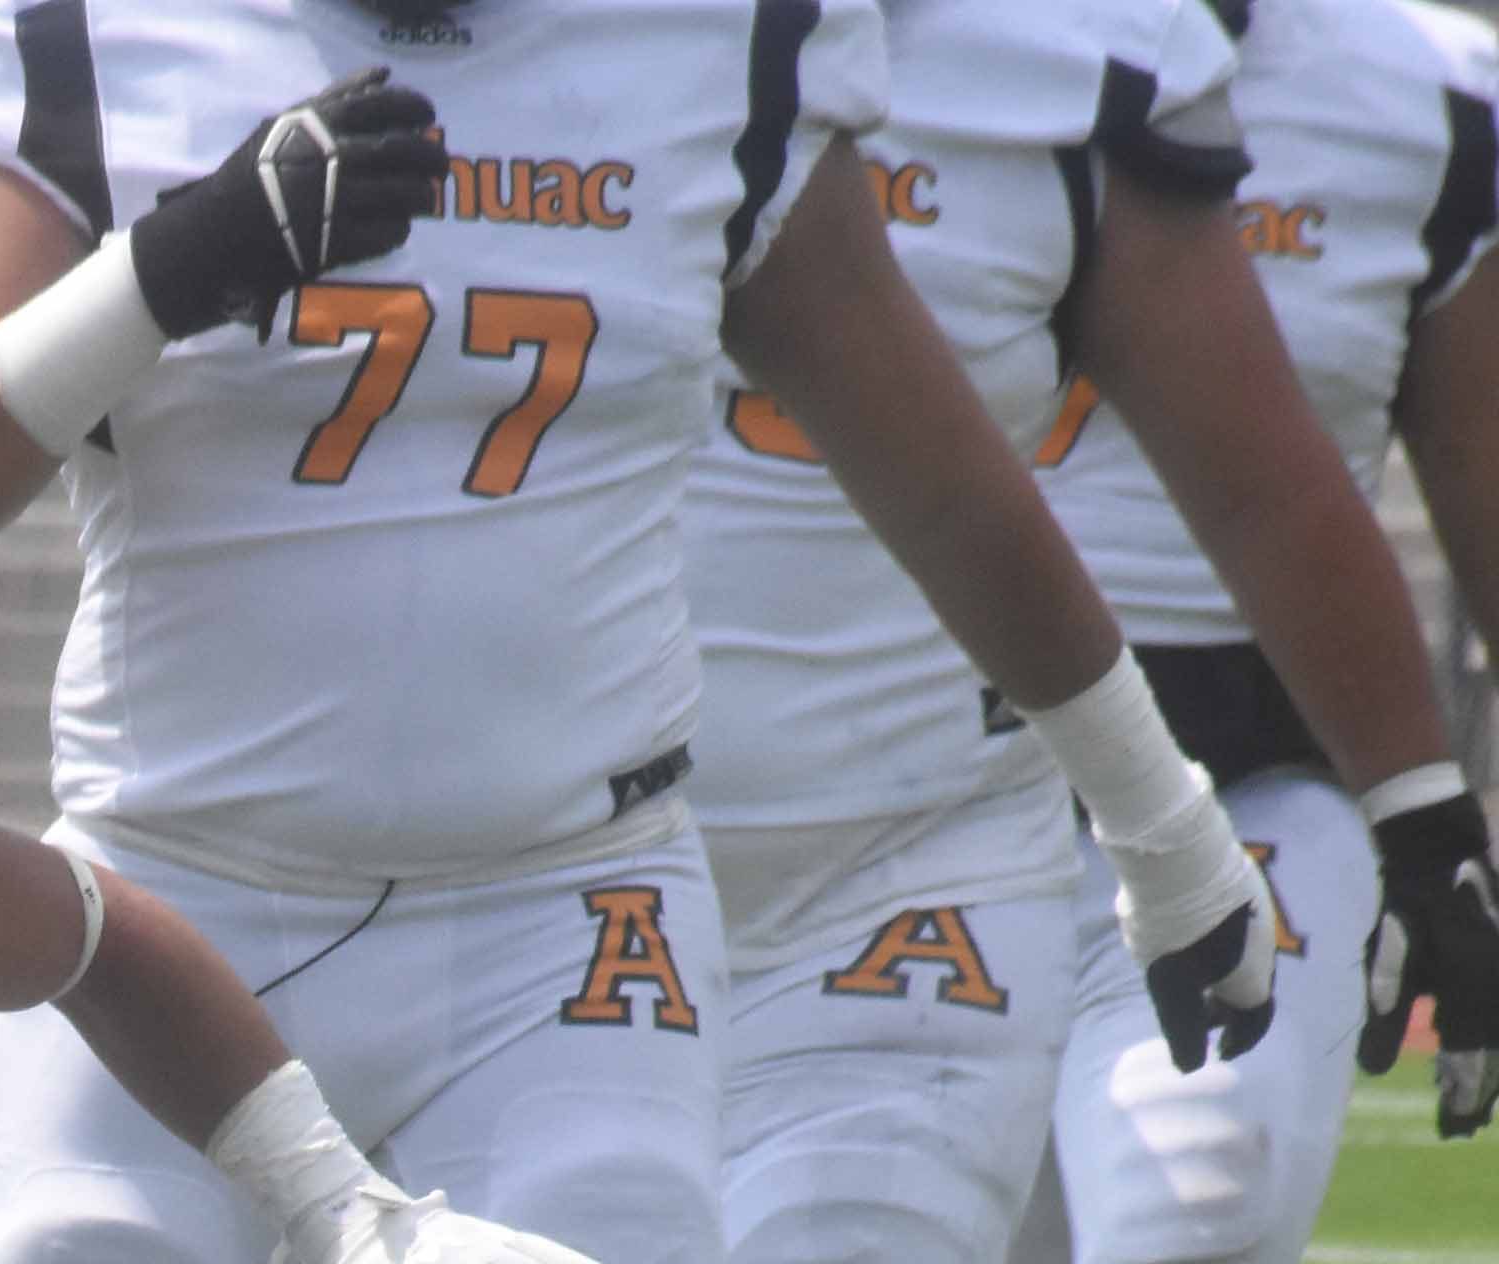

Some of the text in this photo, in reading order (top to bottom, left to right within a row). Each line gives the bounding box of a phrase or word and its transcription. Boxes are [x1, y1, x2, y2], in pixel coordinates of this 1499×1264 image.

[288, 276, 600, 498] 77
[560, 885, 699, 1036] A
[821, 904, 1009, 1016] A
